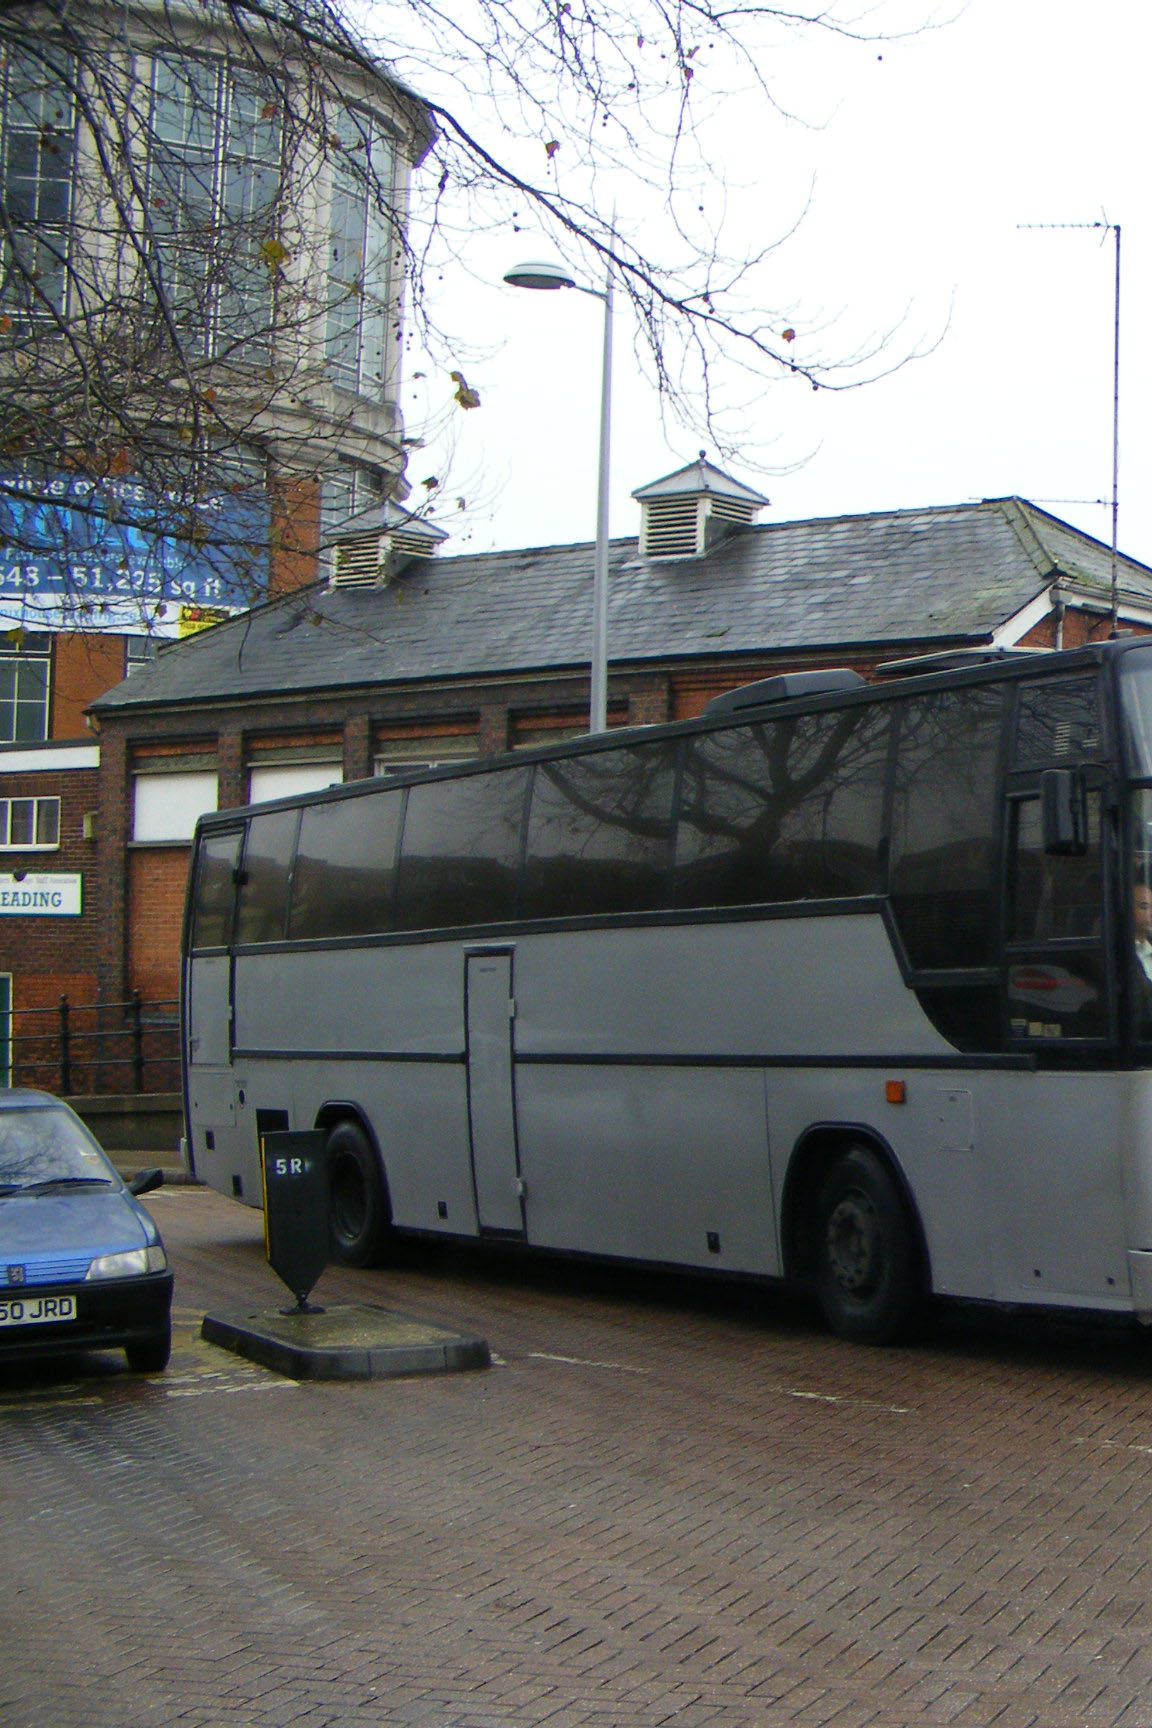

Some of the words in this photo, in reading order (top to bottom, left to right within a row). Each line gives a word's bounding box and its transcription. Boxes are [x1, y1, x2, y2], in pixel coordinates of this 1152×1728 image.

[73, 566, 162, 593] 51,225
[171, 580, 196, 598] sq
[1, 891, 63, 908] EADING
[30, 1298, 73, 1319] JRD
